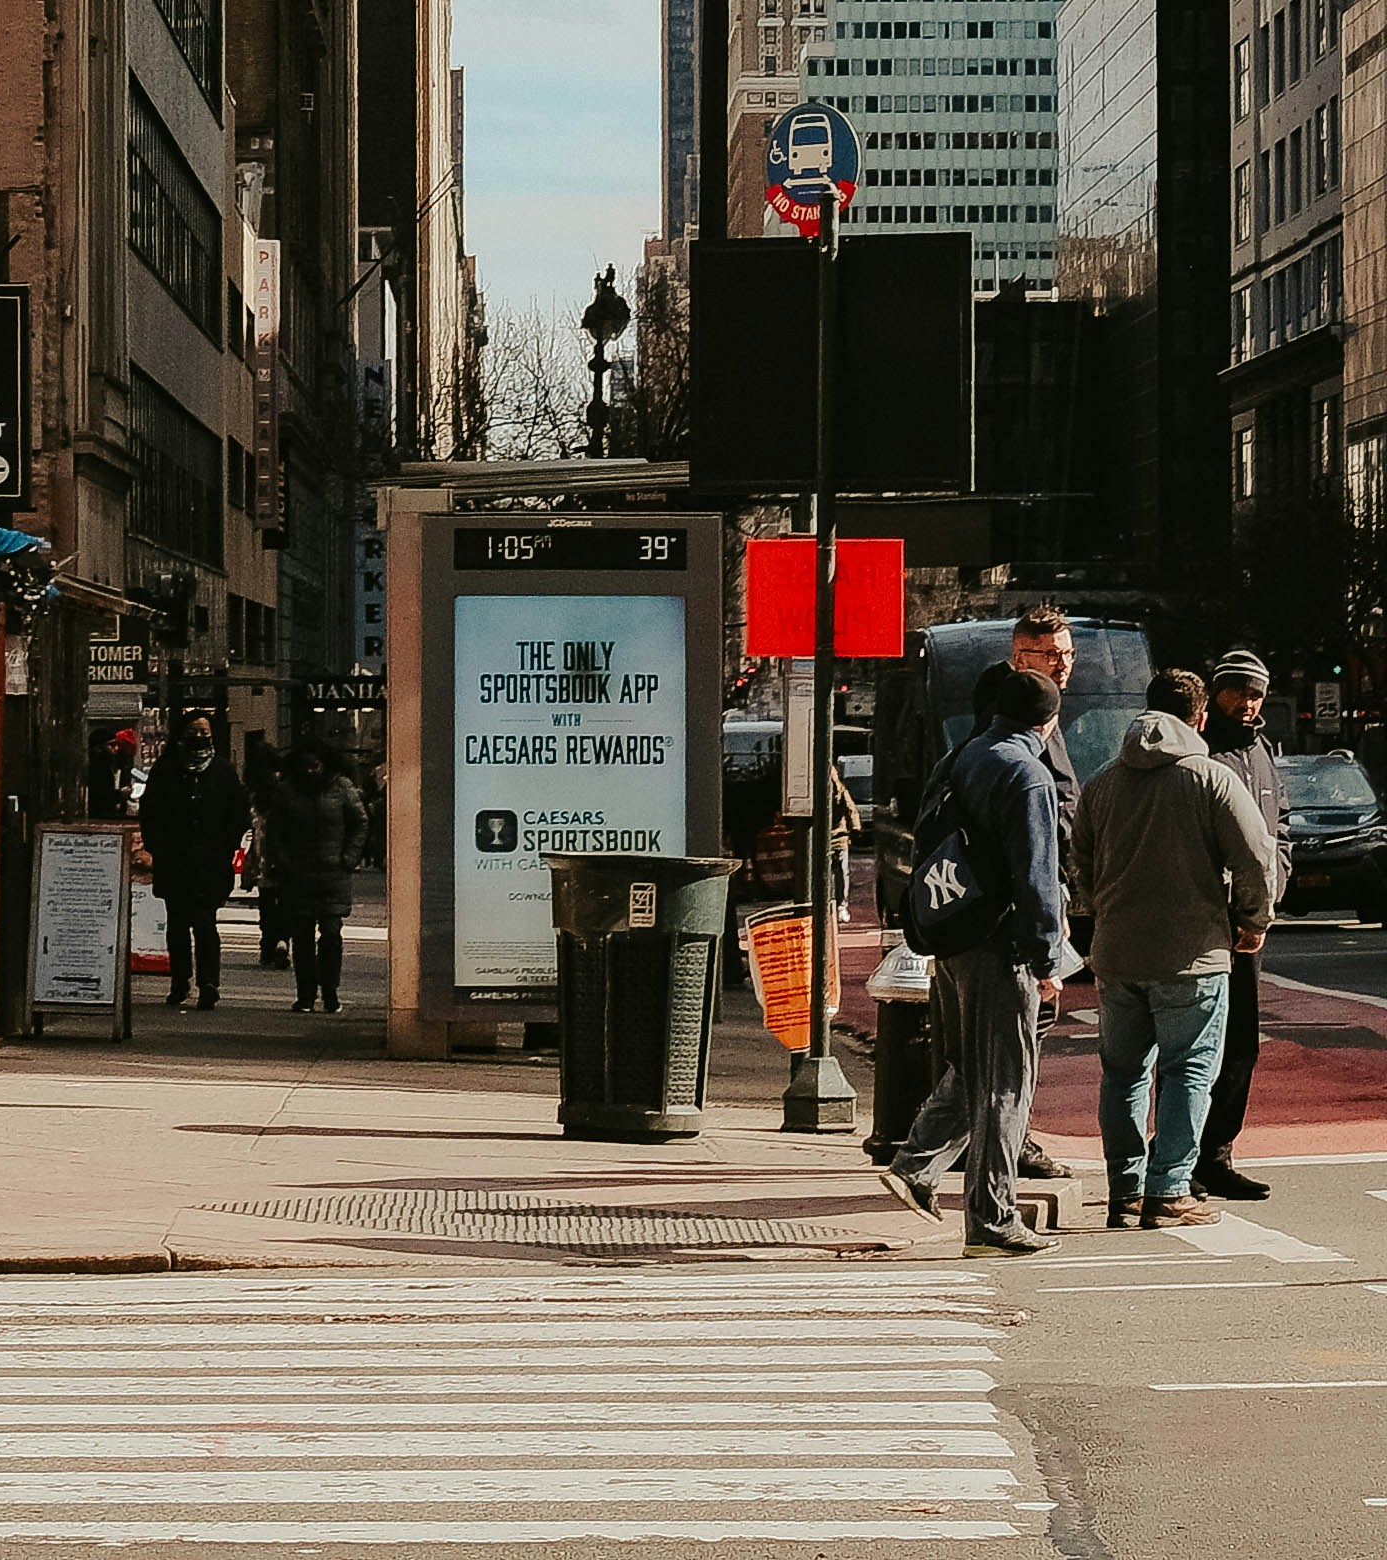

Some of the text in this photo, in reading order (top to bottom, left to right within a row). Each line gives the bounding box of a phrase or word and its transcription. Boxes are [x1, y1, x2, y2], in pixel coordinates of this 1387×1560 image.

[772, 191, 790, 213] NO
[487, 535, 534, 560] 1:05
[515, 640, 617, 671] THE ONLY
[479, 673, 660, 704] SPORTSBOOK APP
[551, 713, 582, 727] WITH
[1317, 703, 1338, 718] 25
[464, 735, 558, 766] CAESARS
[522, 809, 662, 853] CAESARS SPORTSBOOK
[476, 859, 513, 871] WITH
[923, 858, 967, 910] NY
